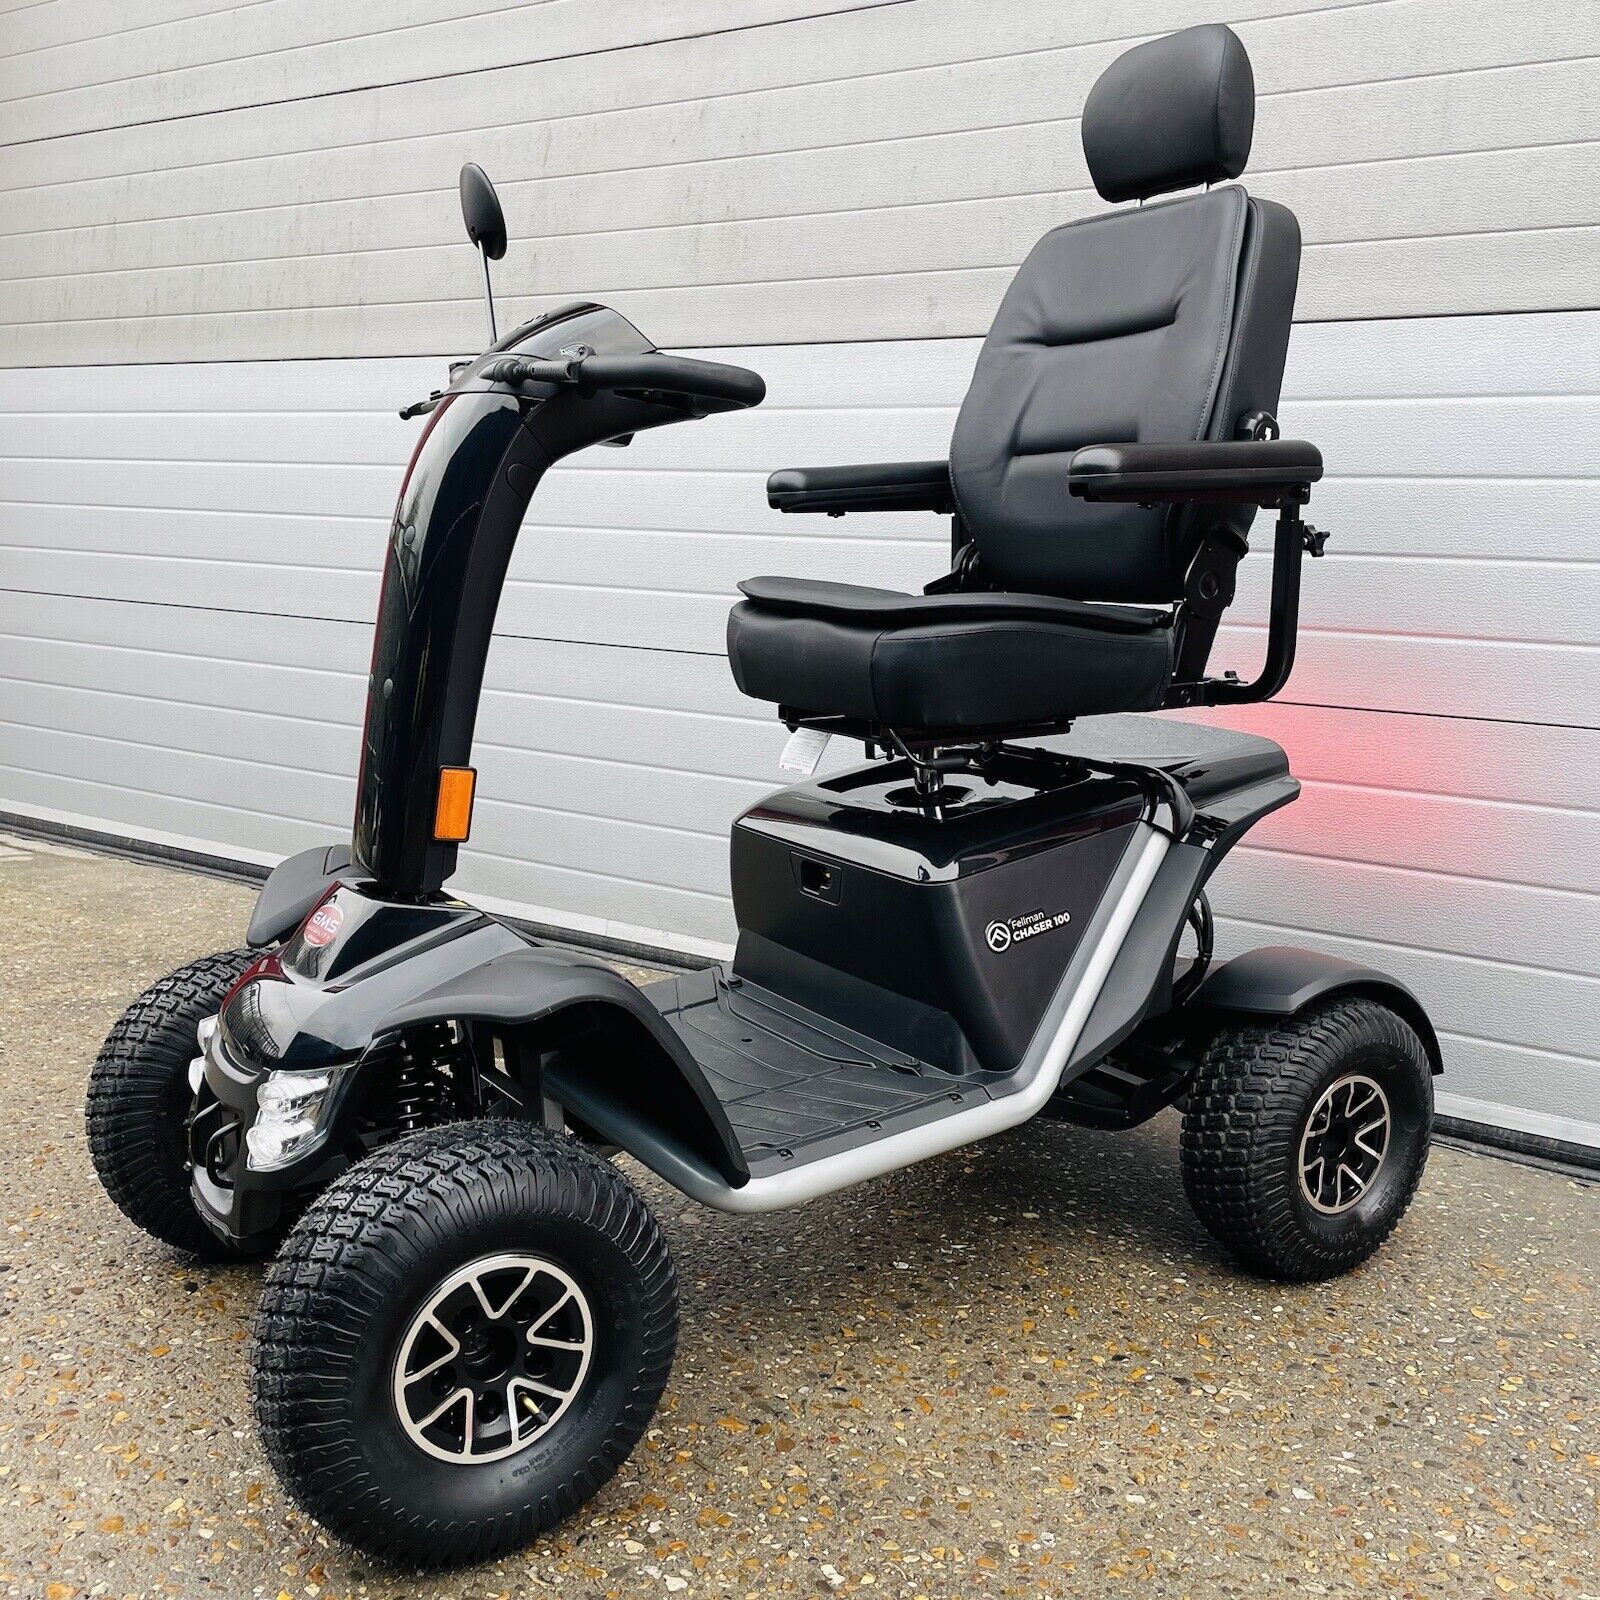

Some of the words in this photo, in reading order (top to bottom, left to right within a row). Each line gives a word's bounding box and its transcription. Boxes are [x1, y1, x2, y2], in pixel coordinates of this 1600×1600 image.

[312, 911, 341, 933] GMS
[1011, 911, 1045, 930] Fellman
[1013, 919, 1053, 942] CHASER
[1053, 911, 1071, 927] 100
